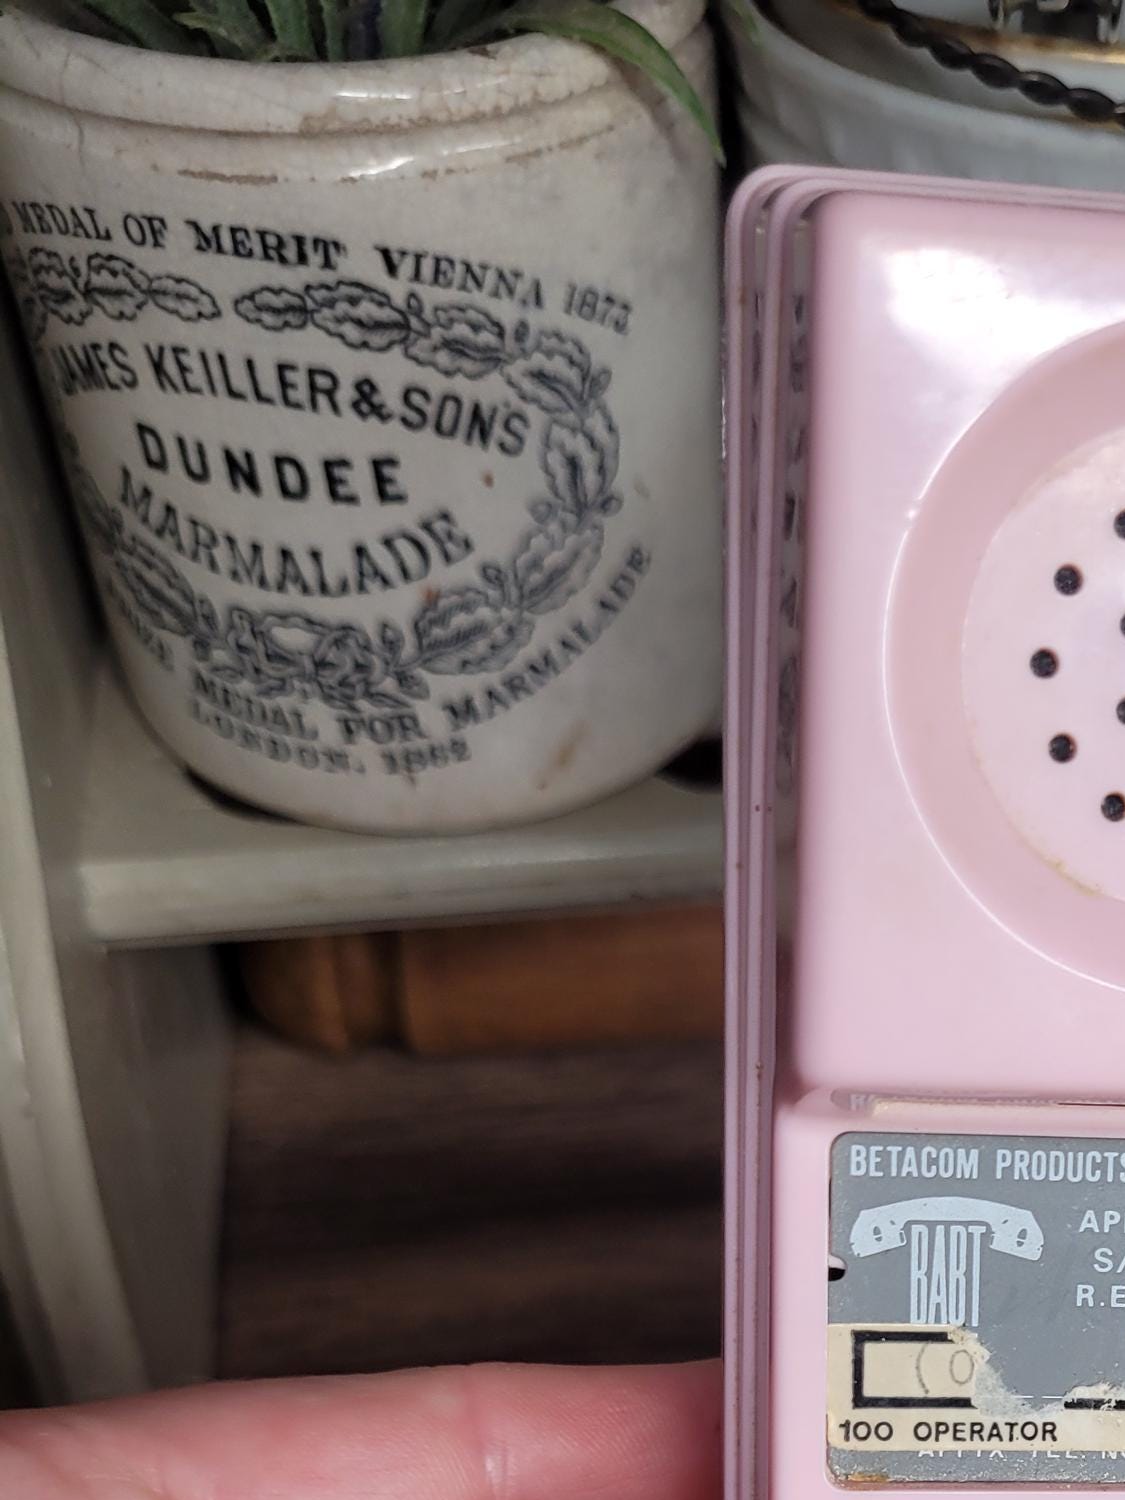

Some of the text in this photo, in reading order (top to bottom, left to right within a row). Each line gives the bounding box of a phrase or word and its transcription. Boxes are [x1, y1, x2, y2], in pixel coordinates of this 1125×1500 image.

[122, 212, 168, 250] OF
[184, 219, 344, 271] MERIT
[372, 244, 544, 310] VIENNA
[143, 342, 343, 417] KEILLER
[135, 420, 409, 505] DUNDEE
[118, 461, 475, 599] MARMALADE
[850, 1144, 979, 1180] BETACOM
[909, 1224, 987, 1327] BABT
[838, 1418, 1058, 1443] 100 OPERATOR
